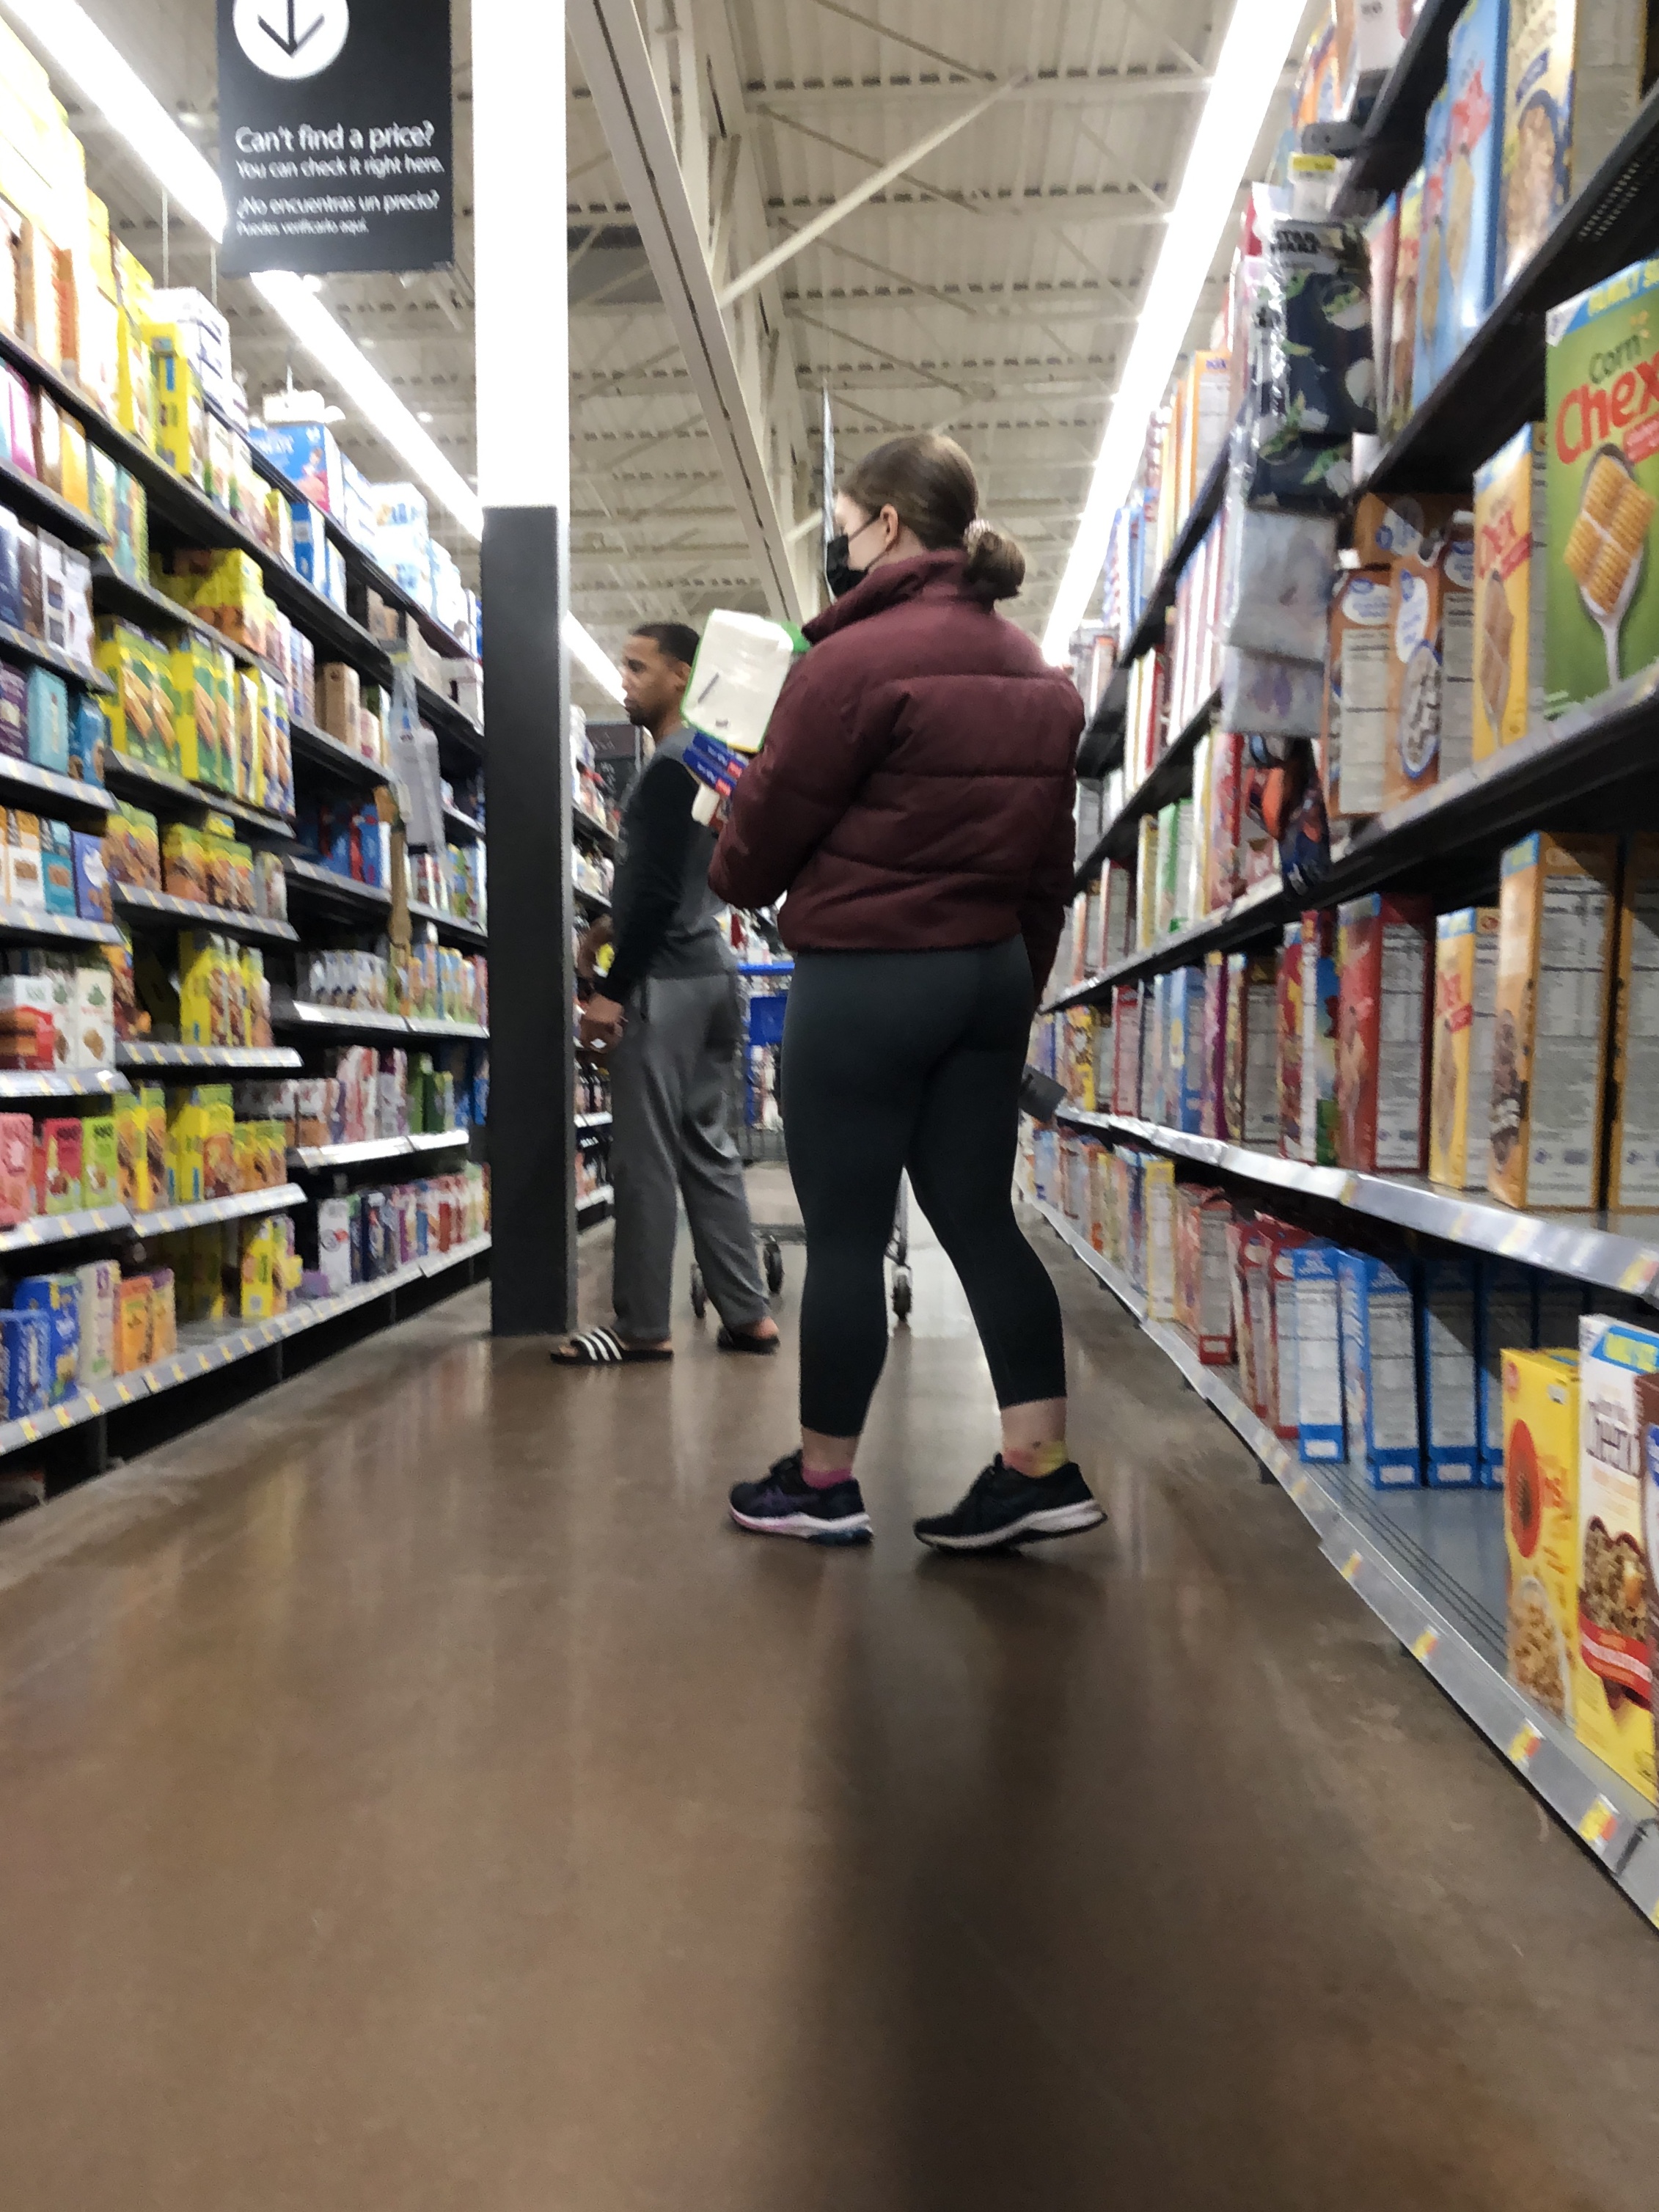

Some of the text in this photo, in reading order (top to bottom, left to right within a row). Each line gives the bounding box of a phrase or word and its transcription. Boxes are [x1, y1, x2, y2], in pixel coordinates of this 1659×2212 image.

[235, 119, 435, 154] Can't find a price?
[235, 159, 267, 179] You
[268, 161, 299, 178] can
[300, 155, 348, 177] check
[349, 155, 362, 176] it
[364, 154, 403, 180] right
[358, 194, 381, 213] un
[381, 188, 440, 216] precio?
[1589, 334, 1641, 384] Corn
[1555, 350, 1659, 465] Chex
